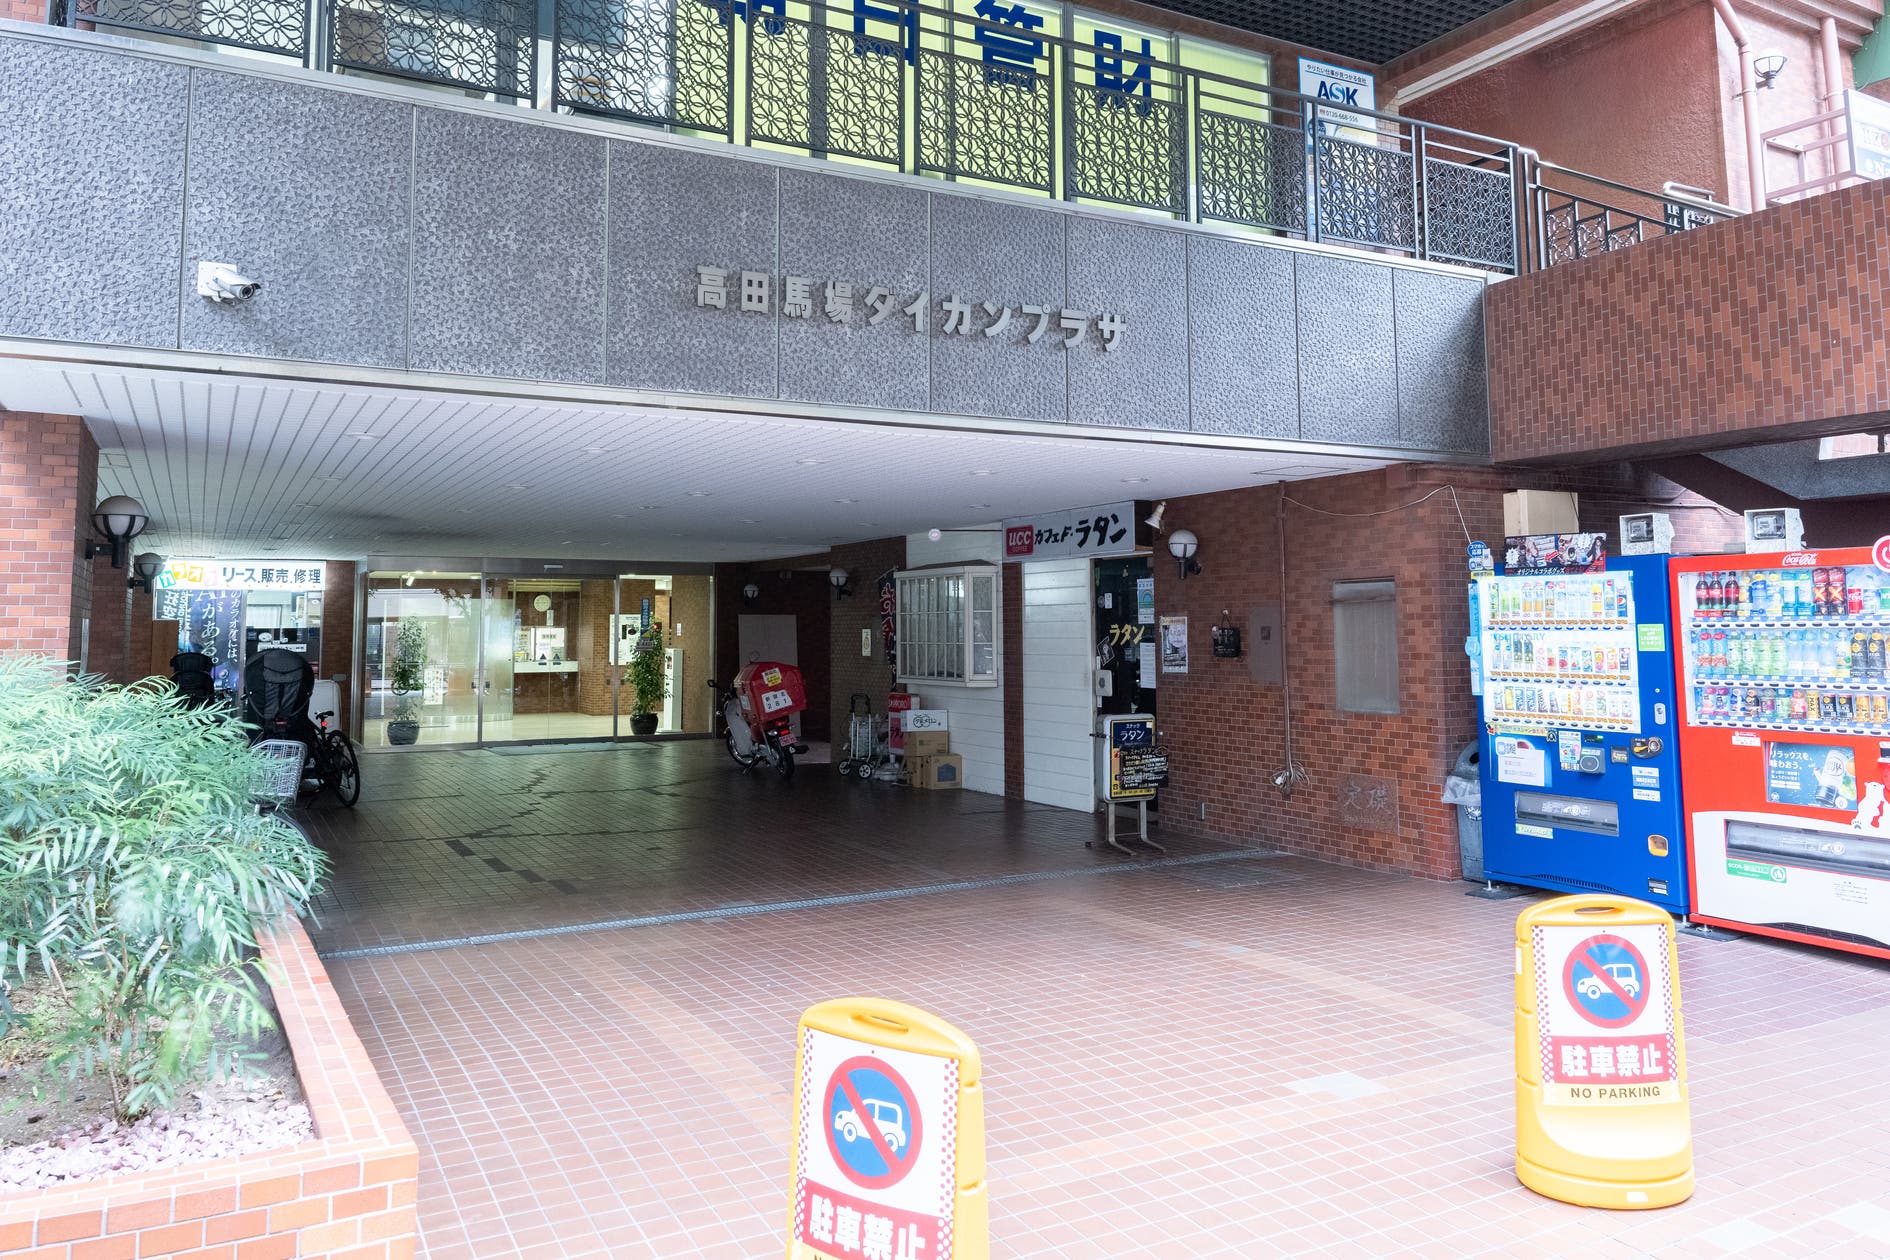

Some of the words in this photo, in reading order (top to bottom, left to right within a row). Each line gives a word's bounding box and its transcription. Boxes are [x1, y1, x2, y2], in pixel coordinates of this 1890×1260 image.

[1318, 80, 1359, 107] ASK
[697, 265, 1129, 352] 高田馬場ダイカンプラザ
[1008, 530, 1032, 546] UCC
[1782, 552, 1819, 566] Coca-Cola
[1109, 623, 1145, 646] ラタン
[1120, 730, 1145, 741] ラタン
[1560, 1043, 1664, 1078] 駐車禁止
[1570, 1087, 1592, 1099] NO
[1599, 1086, 1661, 1099] PARKING
[809, 1193, 927, 1260] 駐車禁止
